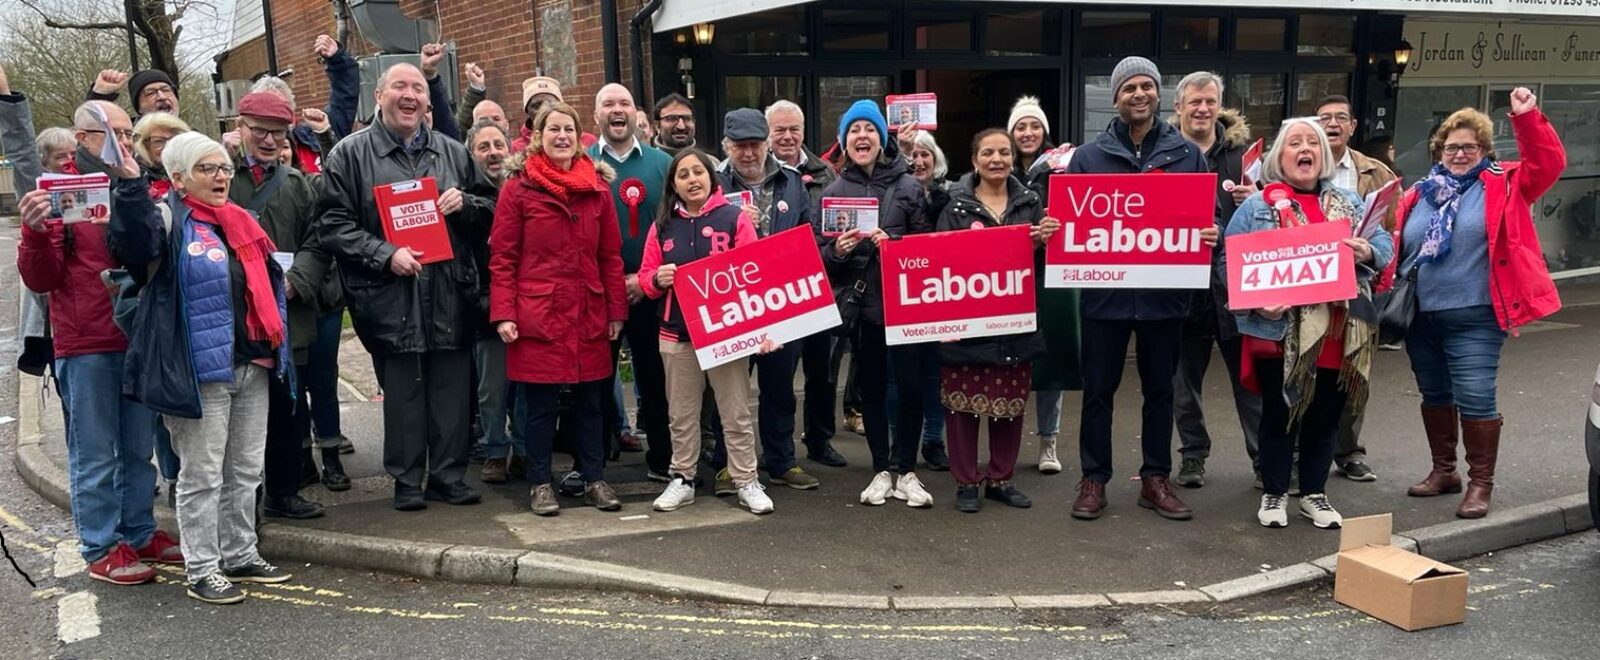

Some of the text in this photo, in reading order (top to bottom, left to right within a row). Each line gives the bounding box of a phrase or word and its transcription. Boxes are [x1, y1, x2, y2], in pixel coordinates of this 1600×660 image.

[1412, 32, 1464, 72] Jordan
[1471, 31, 1488, 69] &
[1492, 32, 1546, 62] Sullivan
[400, 203, 426, 215] VOTE
[1067, 186, 1145, 218] Vote
[395, 214, 437, 229] LABOUR
[709, 231, 731, 255] R
[1242, 241, 1340, 263] Vote Labour
[898, 257, 930, 270] Vote
[1076, 269, 1127, 281] Labour
[1244, 256, 1336, 287] 4 MAY
[687, 261, 762, 300] Vote
[898, 267, 1032, 306] Labour
[698, 271, 825, 334] Labour
[902, 318, 1034, 338] Vote Labour labour.org.uk
